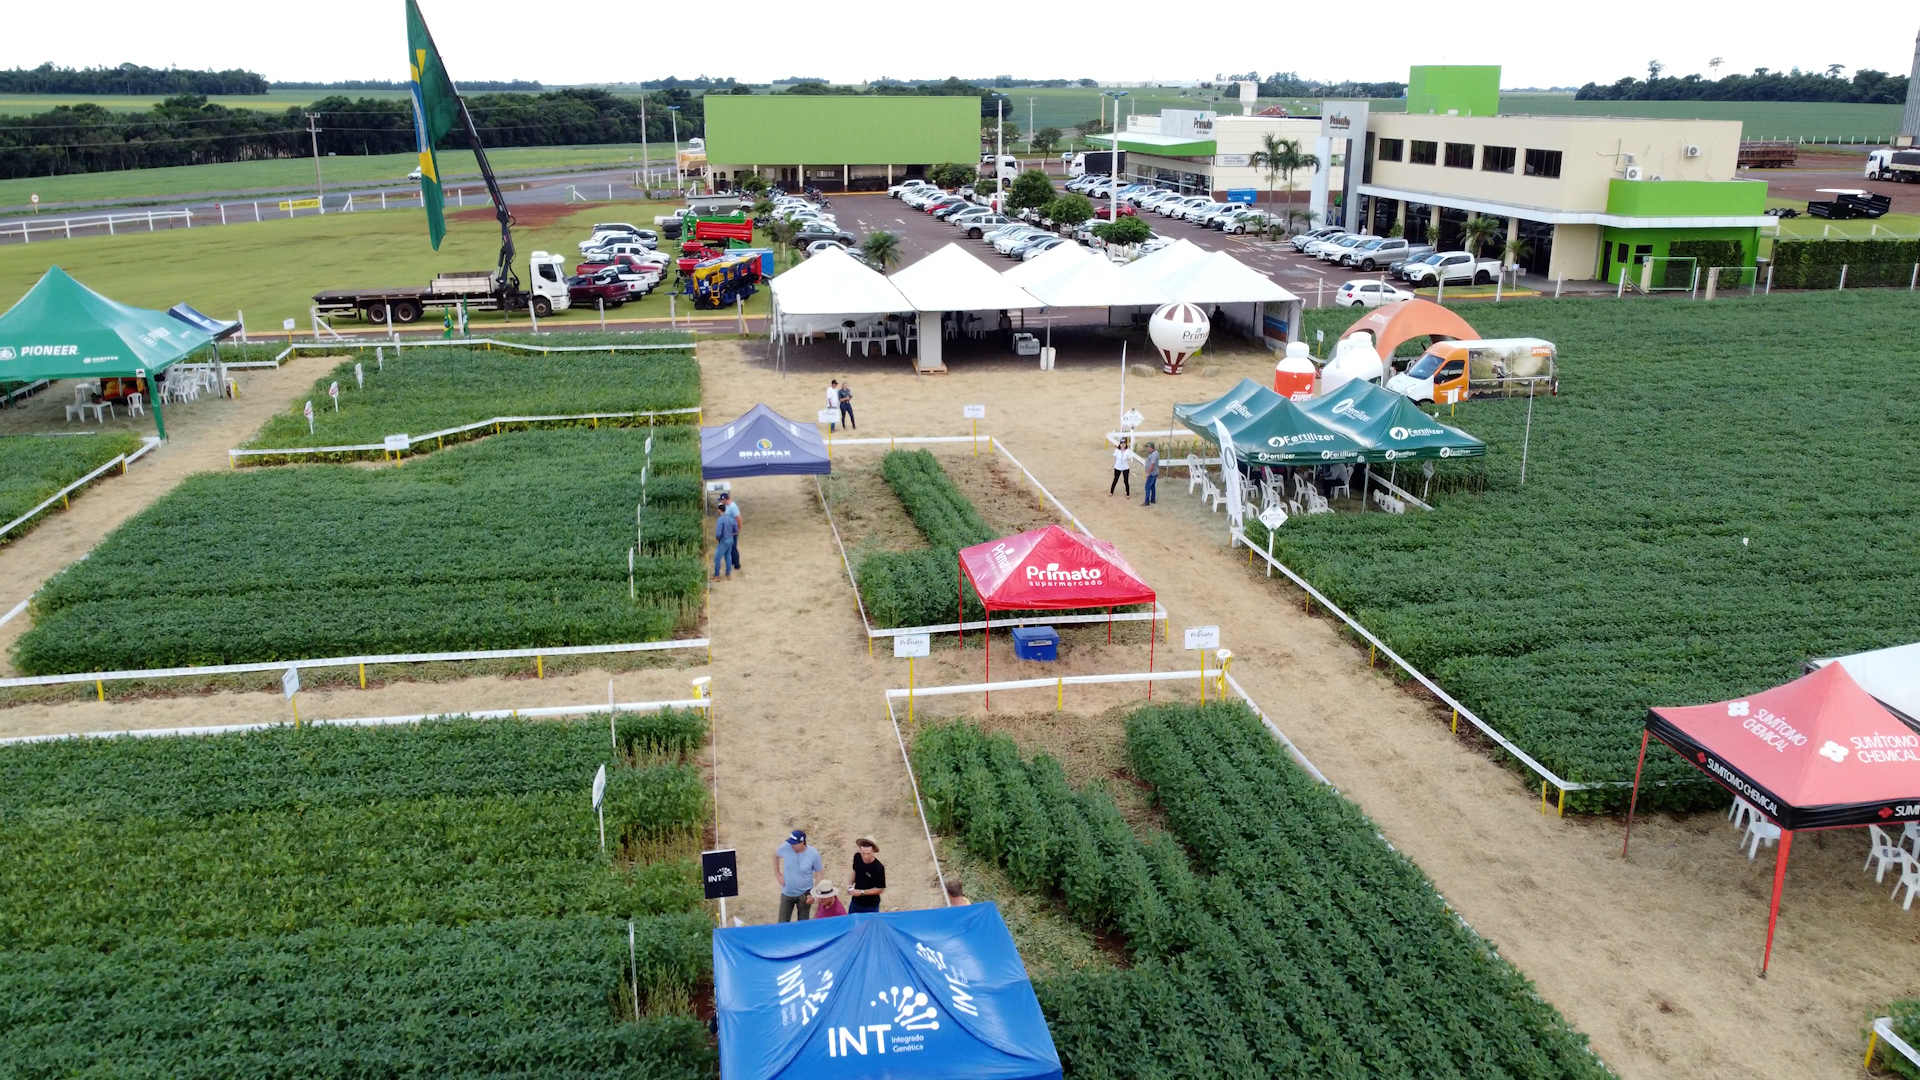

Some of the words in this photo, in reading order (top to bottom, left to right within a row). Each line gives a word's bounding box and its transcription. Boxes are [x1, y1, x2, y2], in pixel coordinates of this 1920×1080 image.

[20, 345, 78, 357] PIONEER
[1407, 428, 1444, 436] Fertilizer
[1283, 432, 1335, 444] Fertilizer
[739, 450, 791, 458] BRASMAX
[1266, 452, 1296, 460] Fertilizer
[1329, 450, 1359, 458] Fertilizer
[1026, 565, 1101, 581] Primato
[1028, 579, 1103, 587] supermercado
[1753, 708, 1808, 747] SUMITOMO
[1742, 718, 1790, 753] CHEMICAL
[1857, 749, 1920, 763] CHEMICAL
[1706, 757, 1744, 792] SUMITOMO
[1743, 783, 1779, 817] CHEMICAL
[707, 874, 722, 883] INT
[827, 1023, 892, 1058] INT
[891, 1033, 925, 1044] Integrado
[892, 1043, 925, 1053] Genética
